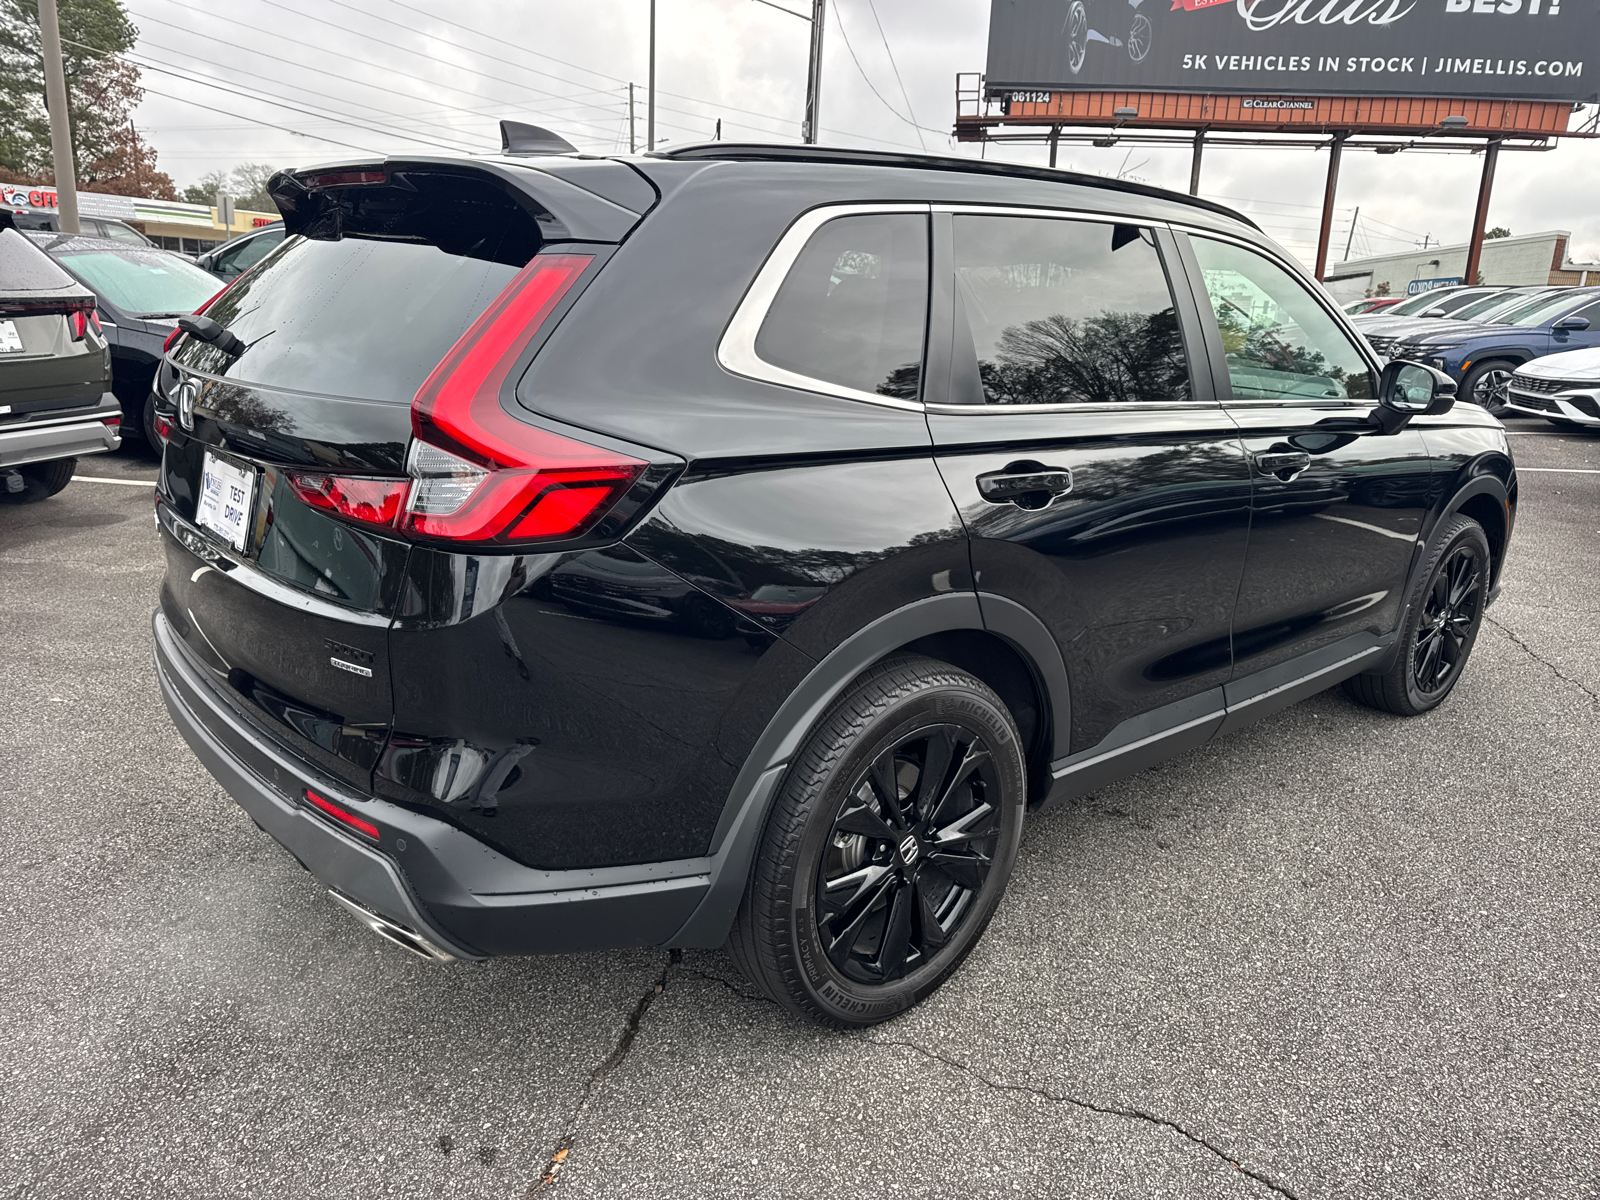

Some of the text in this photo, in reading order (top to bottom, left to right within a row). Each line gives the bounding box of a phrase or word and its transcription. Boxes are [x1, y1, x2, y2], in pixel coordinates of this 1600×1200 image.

[1182, 54, 1208, 70] 5K
[1215, 55, 1311, 71] VEHICLES
[1318, 57, 1340, 72] IN
[1346, 57, 1415, 73] STOCK
[1434, 58, 1583, 77] JIMELLIS.COM
[1012, 91, 1050, 103] 061124
[29, 190, 58, 208] CIT
[230, 485, 245, 505] TEST
[224, 504, 243, 527] DRIVE
[958, 700, 1008, 740] MICHELIN
[800, 938, 819, 982] PRIMACY
[821, 984, 886, 1014] MICHELIN
